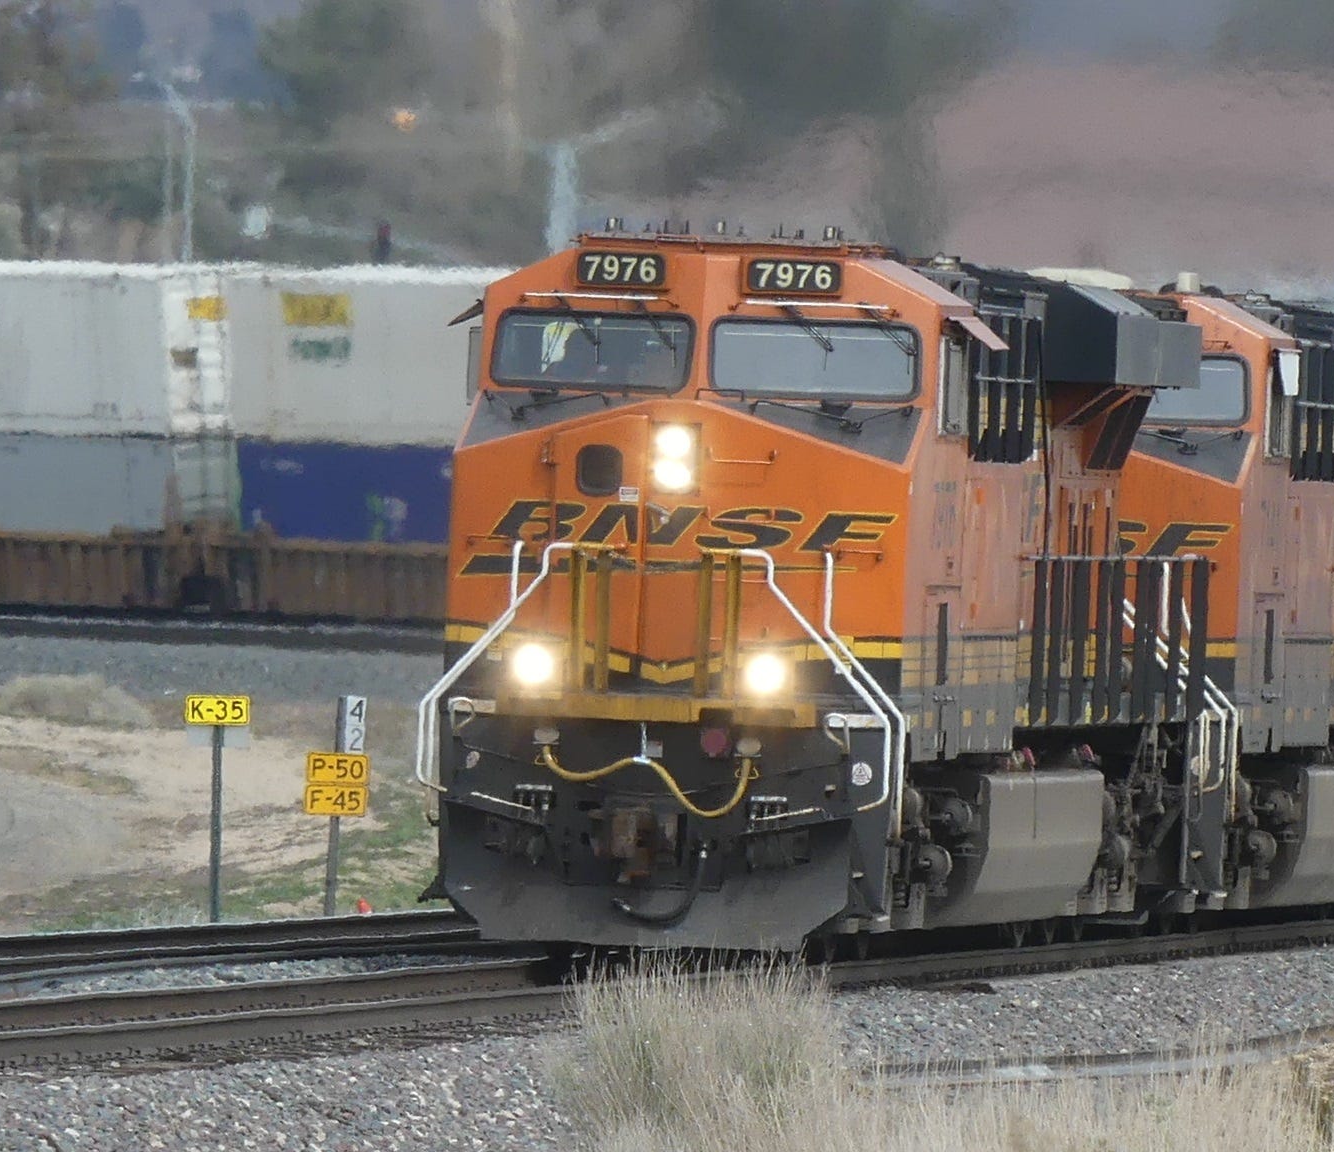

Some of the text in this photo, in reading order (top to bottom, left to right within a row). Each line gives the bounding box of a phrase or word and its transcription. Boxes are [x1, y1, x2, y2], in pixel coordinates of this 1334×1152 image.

[585, 255, 657, 283] 7976
[755, 262, 832, 290] 7976
[488, 499, 899, 552] BNSF
[190, 700, 244, 721] K-35
[311, 757, 365, 781] P-50
[309, 789, 362, 812] F-45
